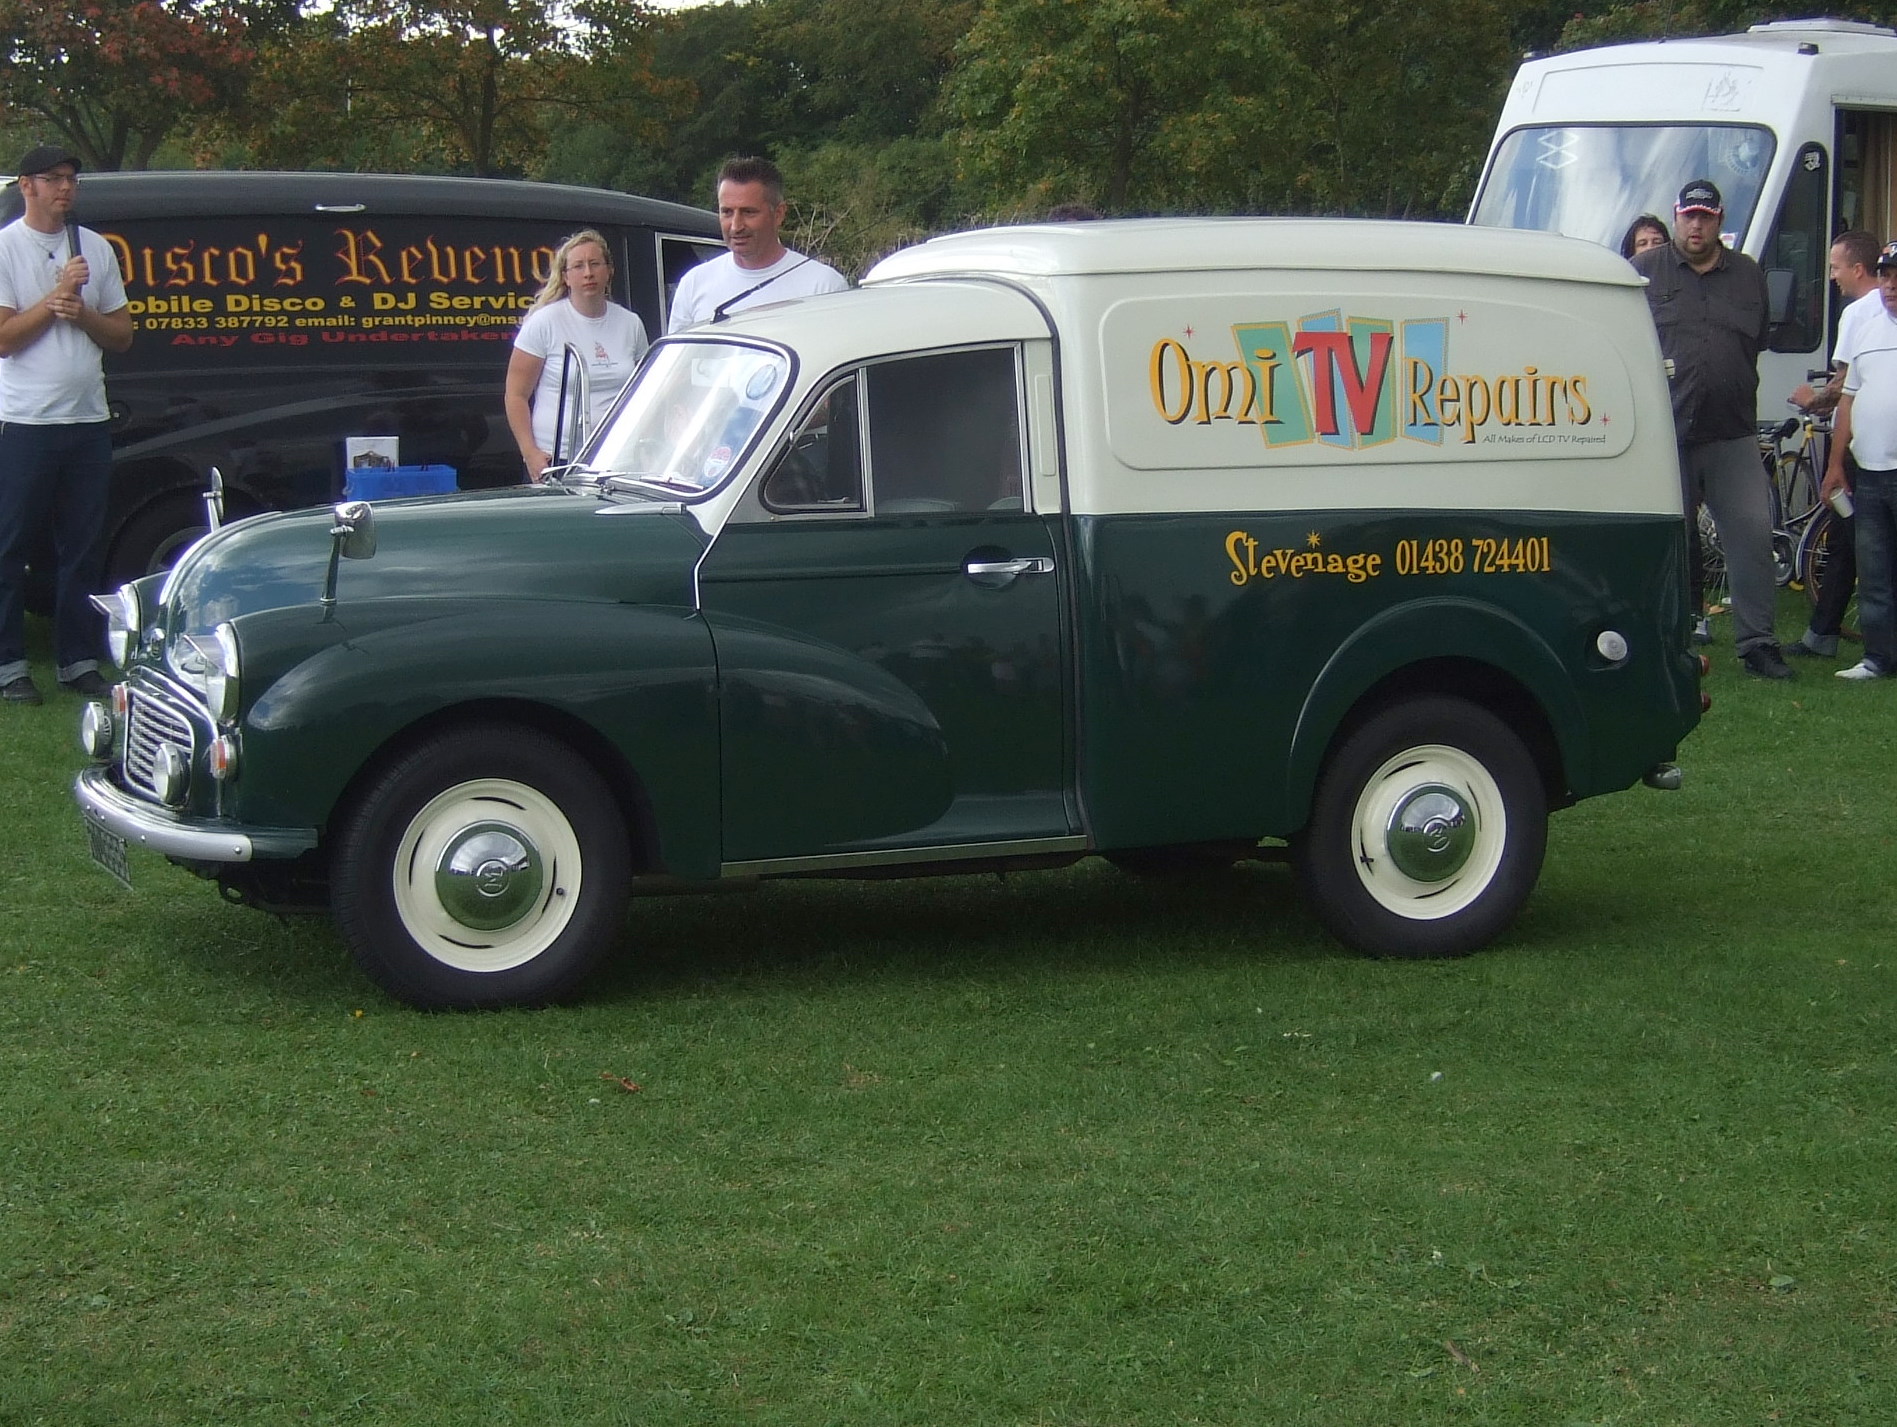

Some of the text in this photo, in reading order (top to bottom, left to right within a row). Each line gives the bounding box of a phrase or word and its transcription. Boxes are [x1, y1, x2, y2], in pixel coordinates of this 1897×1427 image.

[334, 229, 554, 285] Reveng
[128, 291, 538, 315] obile Disco & DJ Servic
[145, 316, 208, 330] 07833
[215, 315, 289, 328] 387792
[295, 314, 356, 327] email:
[170, 333, 239, 347] Any
[250, 332, 310, 346] Gig
[1149, 331, 1592, 444] Omi TV Repairs
[1482, 433, 1496, 444] All
[1499, 434, 1524, 443] Makes
[1537, 434, 1556, 443] LCD
[1557, 434, 1571, 443] TV
[1571, 434, 1606, 445] Repaired
[1224, 530, 1551, 586] Stevenage 01438 724401
